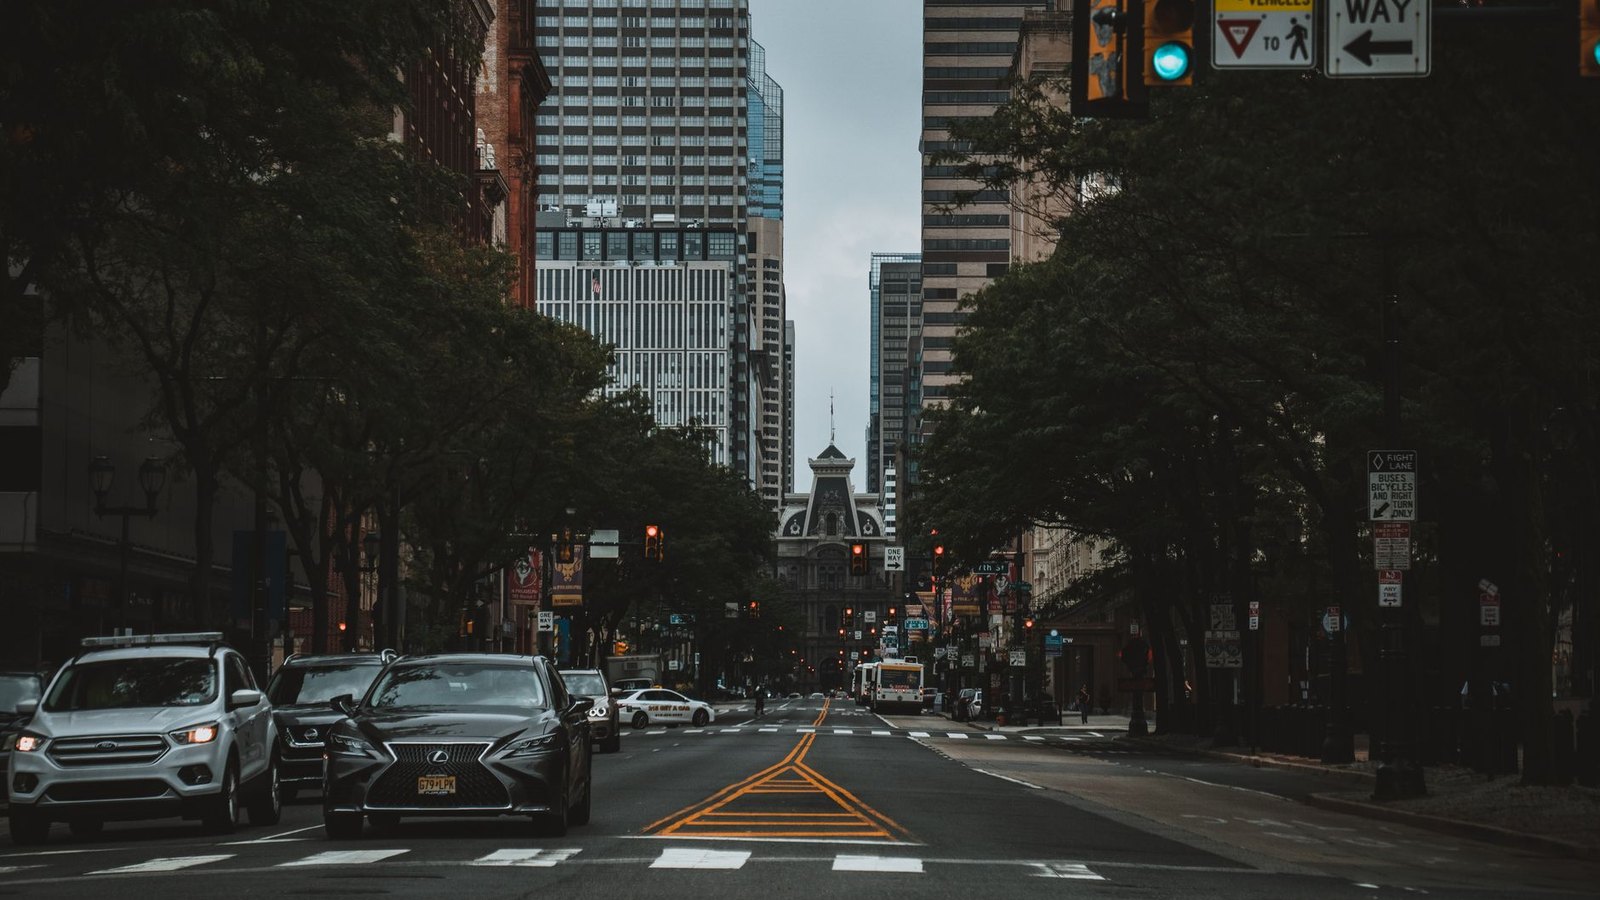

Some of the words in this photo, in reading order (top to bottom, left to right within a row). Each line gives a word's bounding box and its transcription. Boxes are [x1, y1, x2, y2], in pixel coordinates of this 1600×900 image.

[1345, 0, 1411, 23] WAY
[1264, 36, 1280, 51] TO
[1389, 462, 1413, 470] LANE
[1378, 474, 1406, 482] BUSES
[1371, 483, 1413, 491] BICYCLES
[1373, 492, 1388, 500] AND
[1392, 492, 1412, 500] RIGHT
